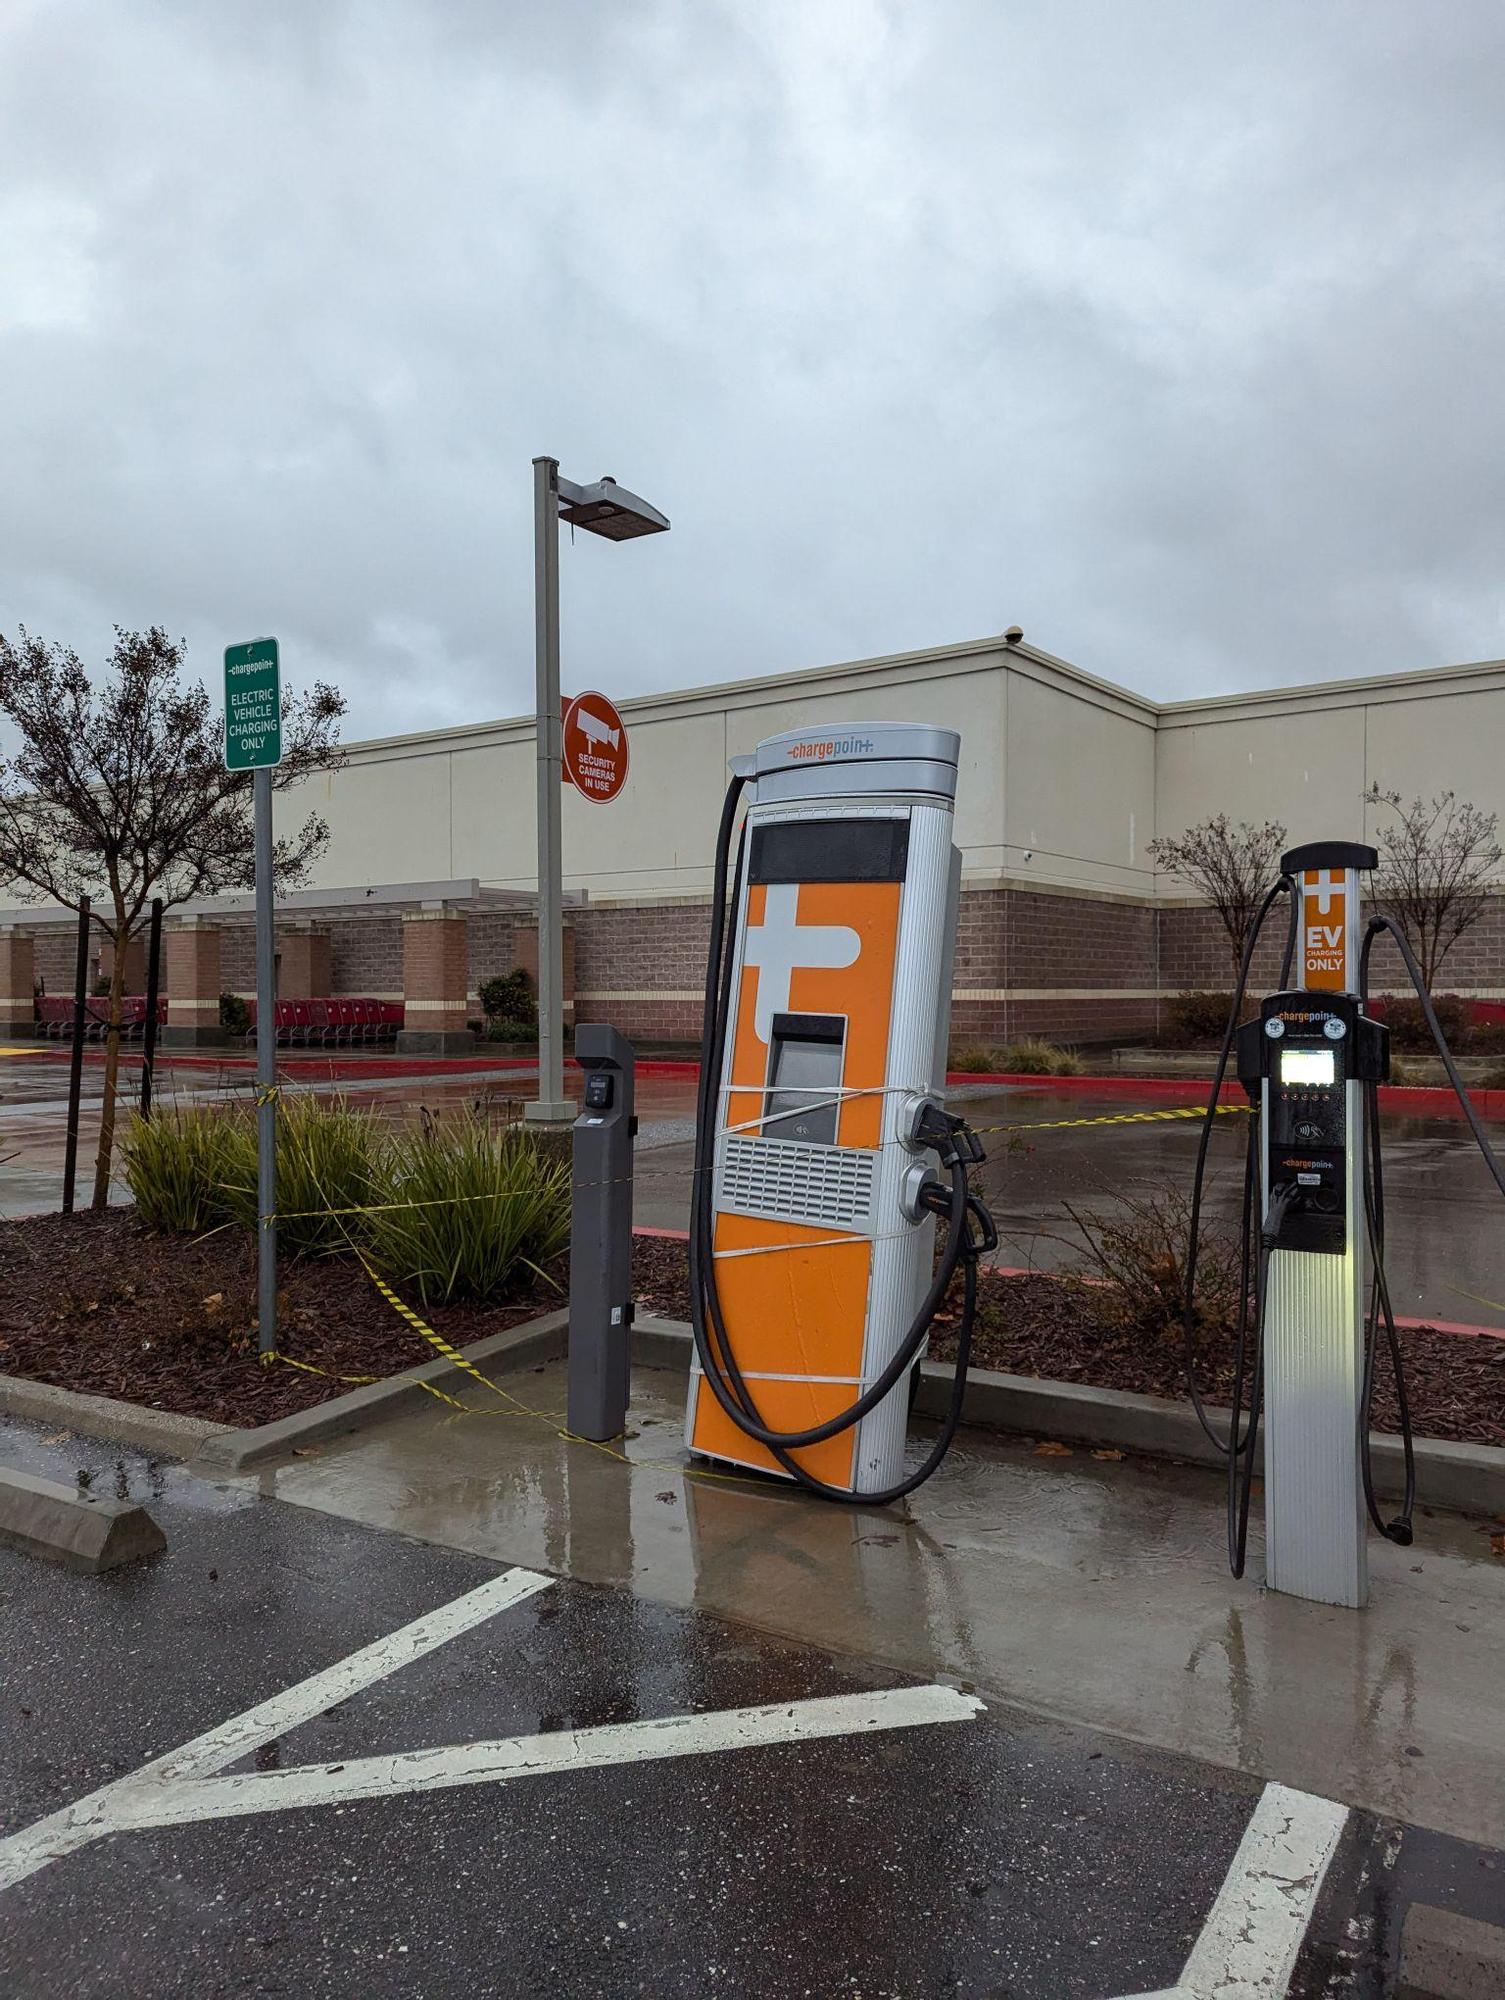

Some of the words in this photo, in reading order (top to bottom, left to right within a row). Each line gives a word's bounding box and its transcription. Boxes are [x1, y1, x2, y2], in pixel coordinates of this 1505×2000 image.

[231, 688, 274, 706] ELECTRIC
[234, 704, 272, 721] VEHICLE
[229, 719, 277, 737] CHARGING
[241, 736, 266, 751] ONLY
[578, 753, 616, 770] SECURITY
[578, 764, 616, 782] CAMERAS
[584, 777, 593, 789] IN
[595, 778, 610, 792] USE
[1307, 926, 1343, 948] EV
[1306, 959, 1344, 971] ONLY
